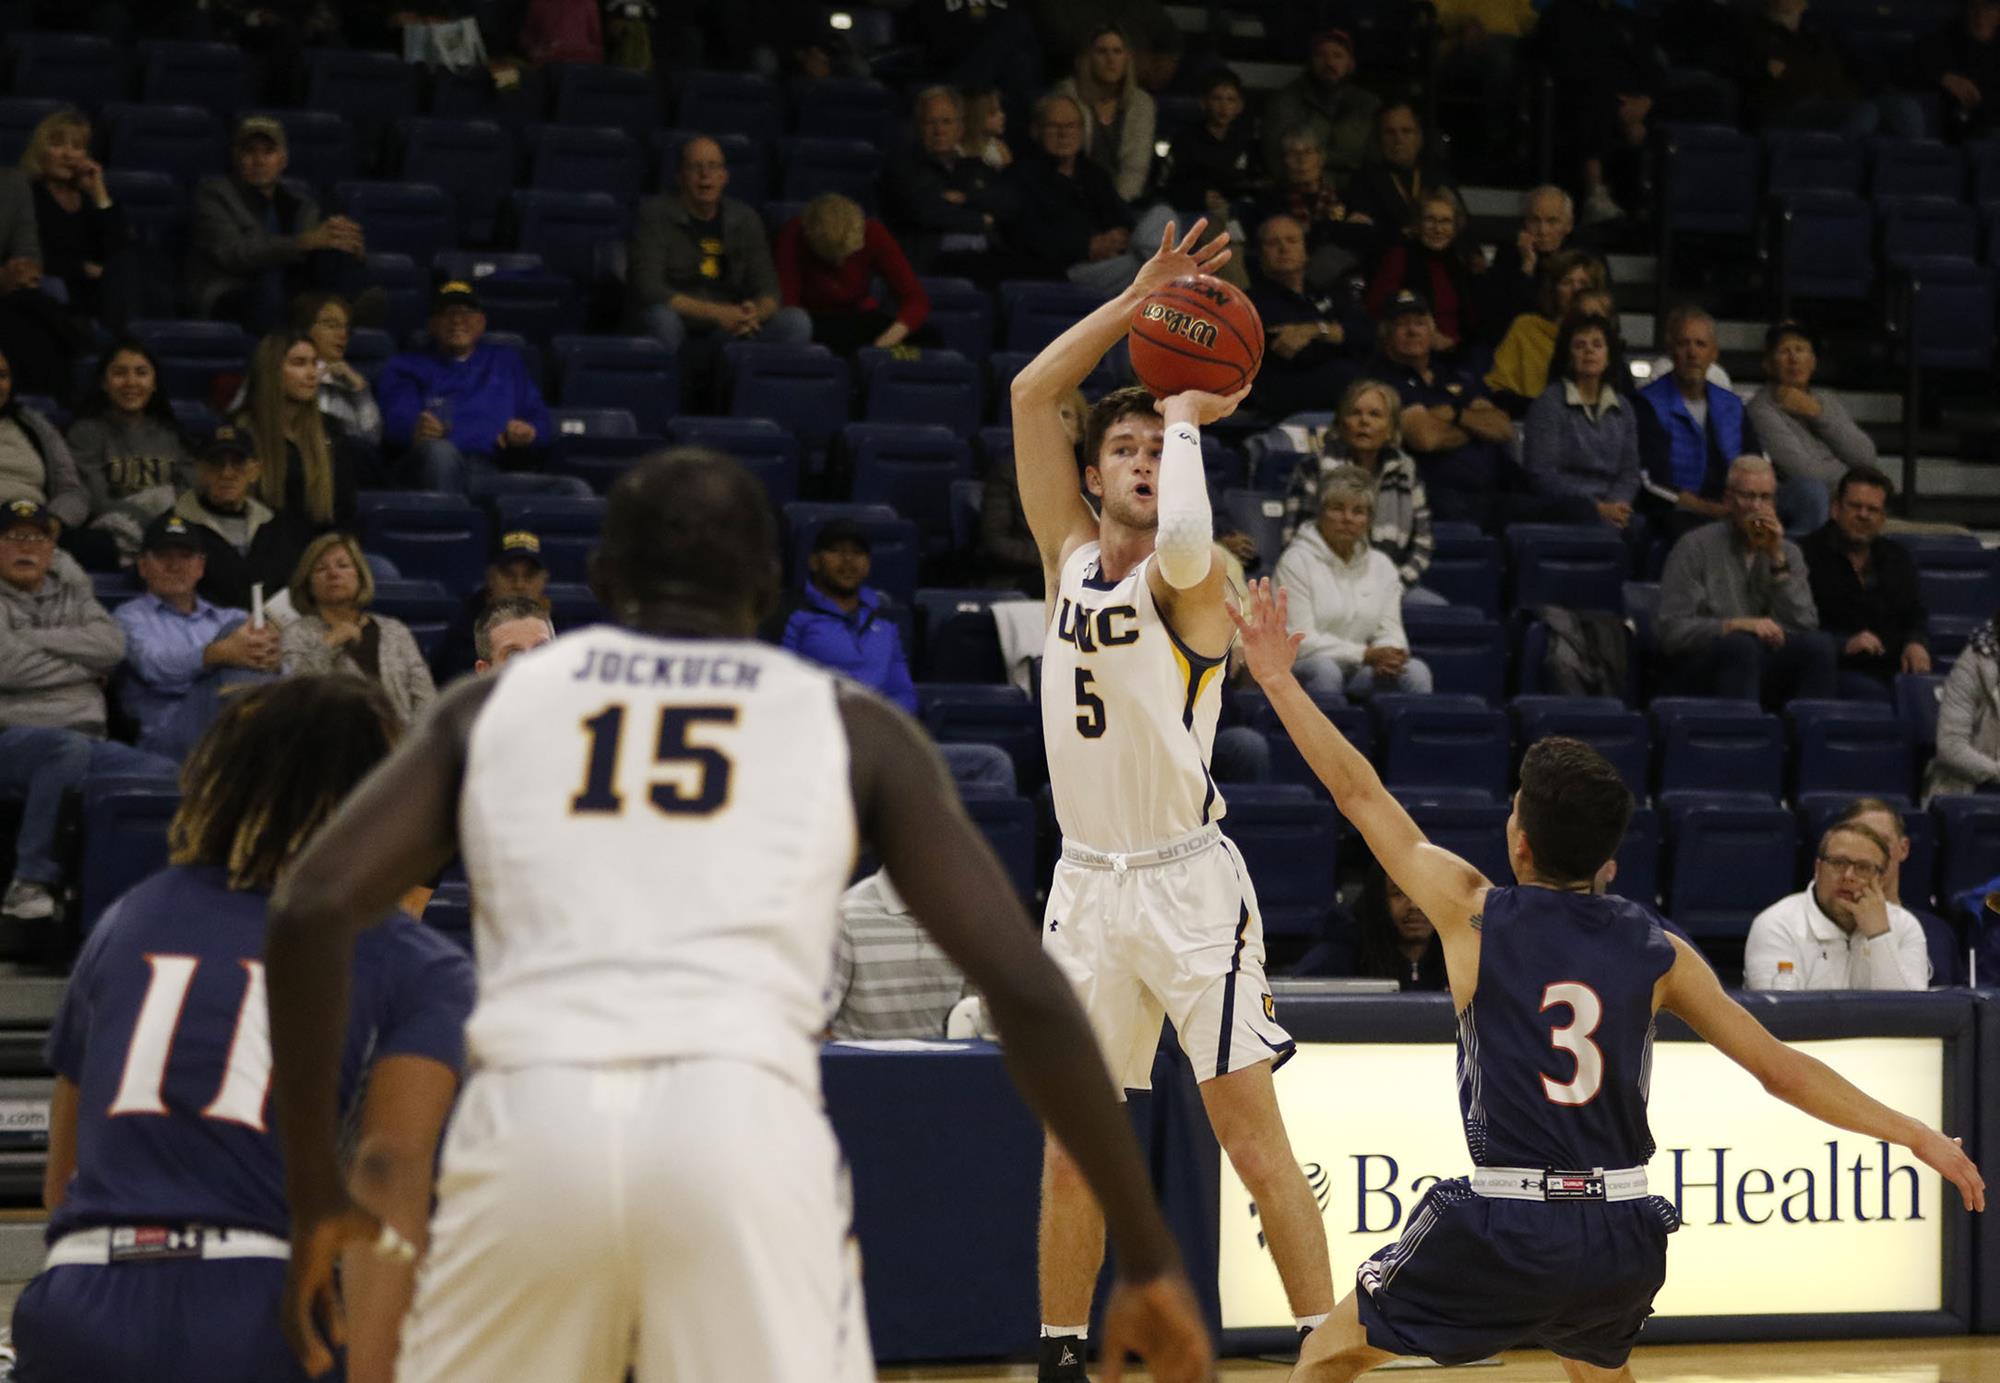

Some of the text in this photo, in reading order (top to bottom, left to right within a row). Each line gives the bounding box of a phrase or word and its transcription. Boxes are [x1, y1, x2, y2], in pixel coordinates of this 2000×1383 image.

[1142, 304, 1218, 350] Wilson
[1058, 598, 1139, 653] UNC
[573, 648, 762, 692] JOCKUCH
[1075, 667, 1106, 738] 5
[568, 701, 741, 820] 15
[1158, 833, 1216, 860] MOUR
[106, 952, 273, 1133] 11
[1539, 980, 1604, 1107] 3
[1667, 1140, 1926, 1226] Health
